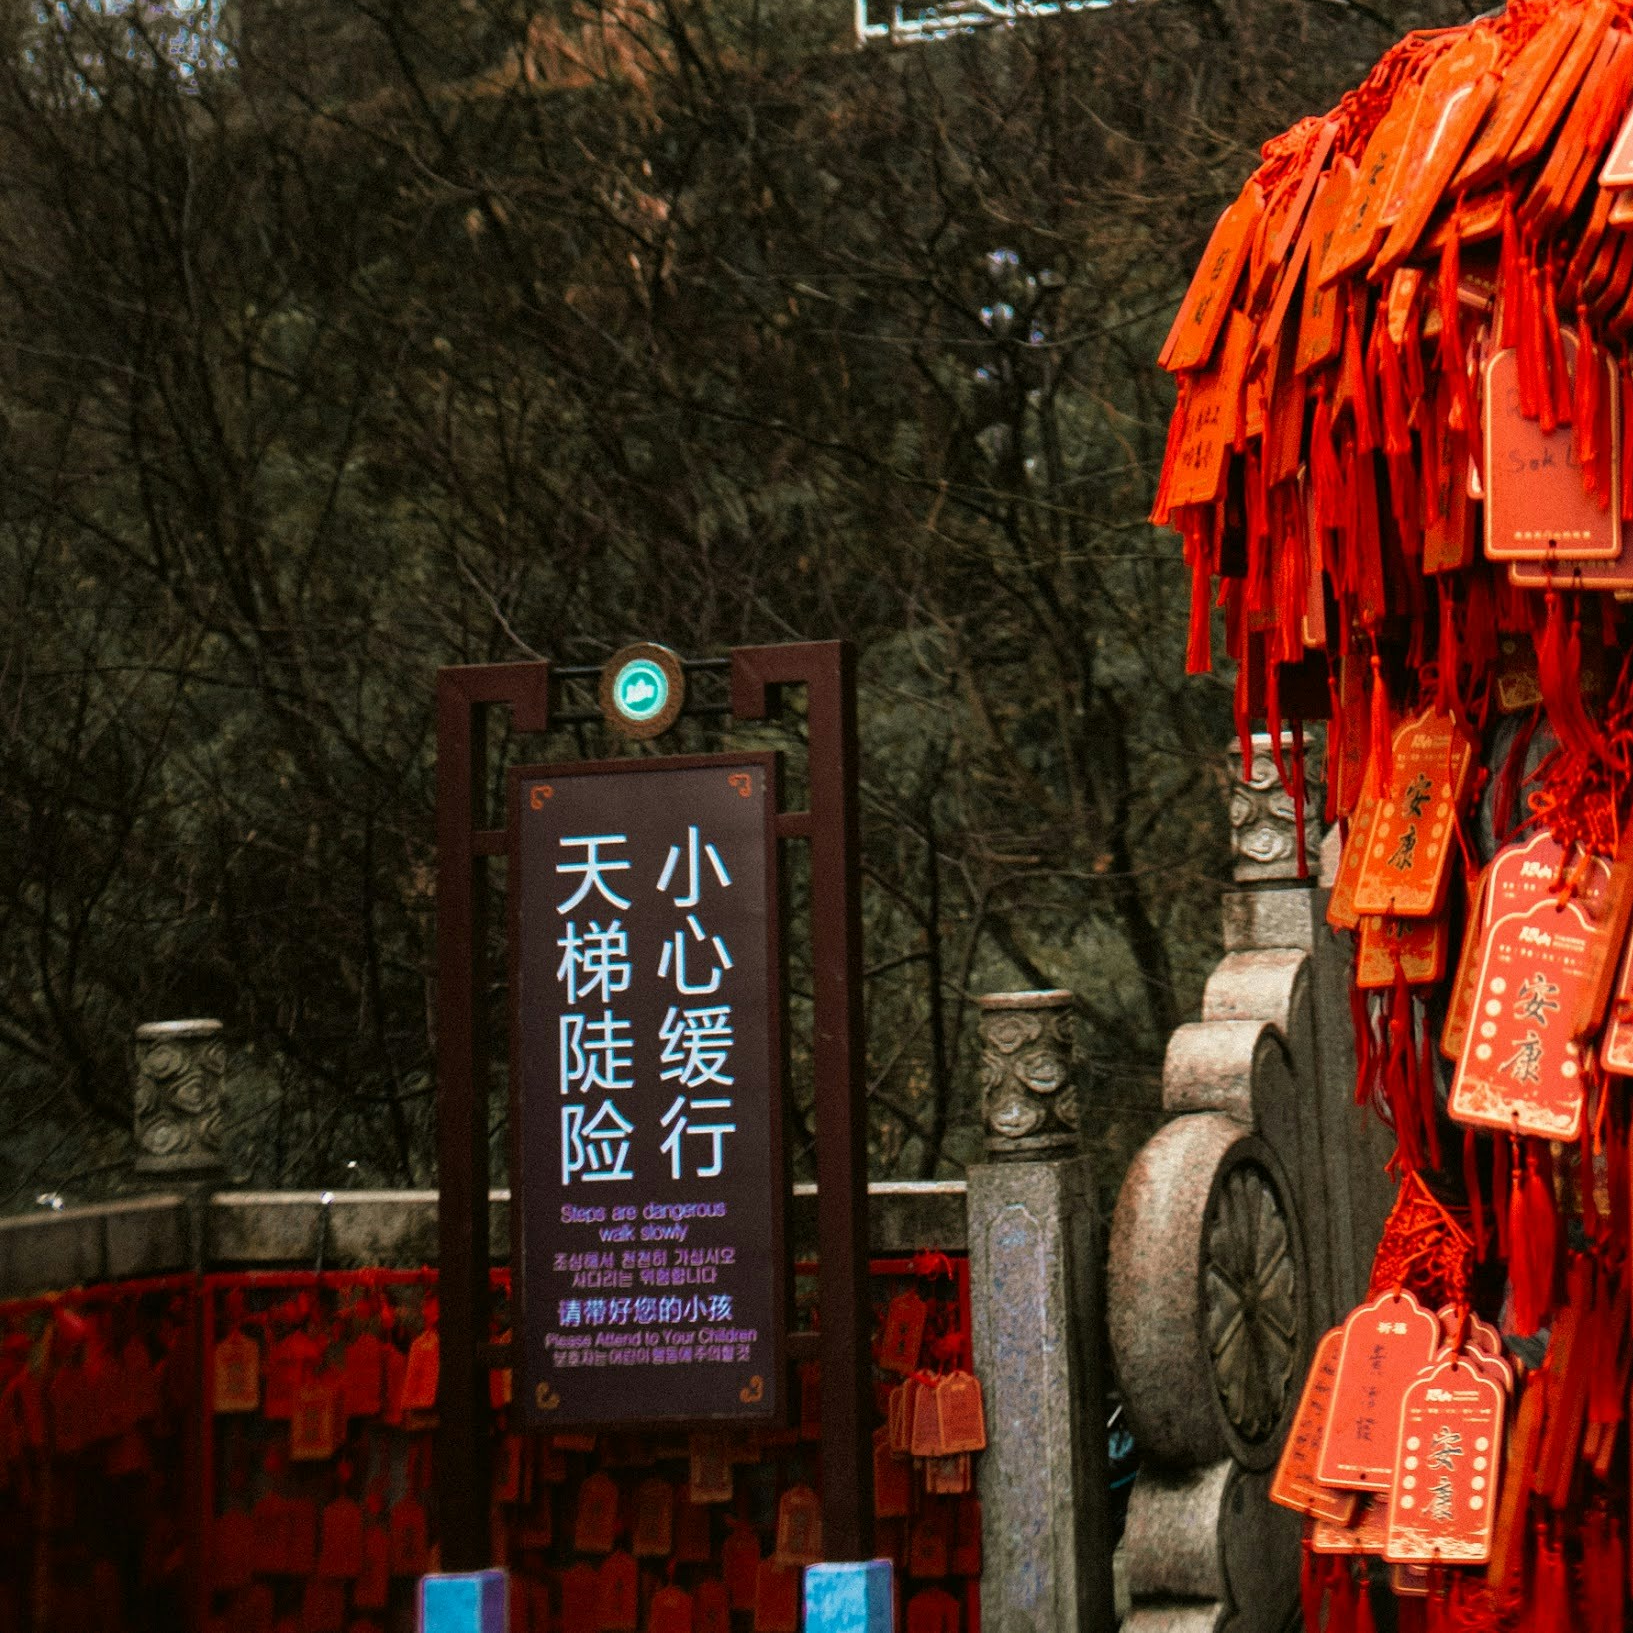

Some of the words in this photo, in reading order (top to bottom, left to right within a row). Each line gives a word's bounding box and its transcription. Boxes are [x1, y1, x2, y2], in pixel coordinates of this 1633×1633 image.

[555, 831, 634, 1186] 天梯陡险
[656, 825, 737, 1181] 小心缓行
[1498, 971, 1561, 1085] 安康
[560, 1203, 606, 1224] Steps
[612, 1205, 638, 1222] are
[643, 1201, 727, 1221] dangerous
[599, 1225, 636, 1242] walk
[640, 1223, 689, 1243] slowly
[558, 1293, 734, 1327] 请带好您的小孩
[544, 1333, 593, 1350] Please
[595, 1331, 642, 1347] Attend
[645, 1331, 659, 1347] to
[663, 1329, 695, 1346] Your
[699, 1327, 758, 1345] Children
